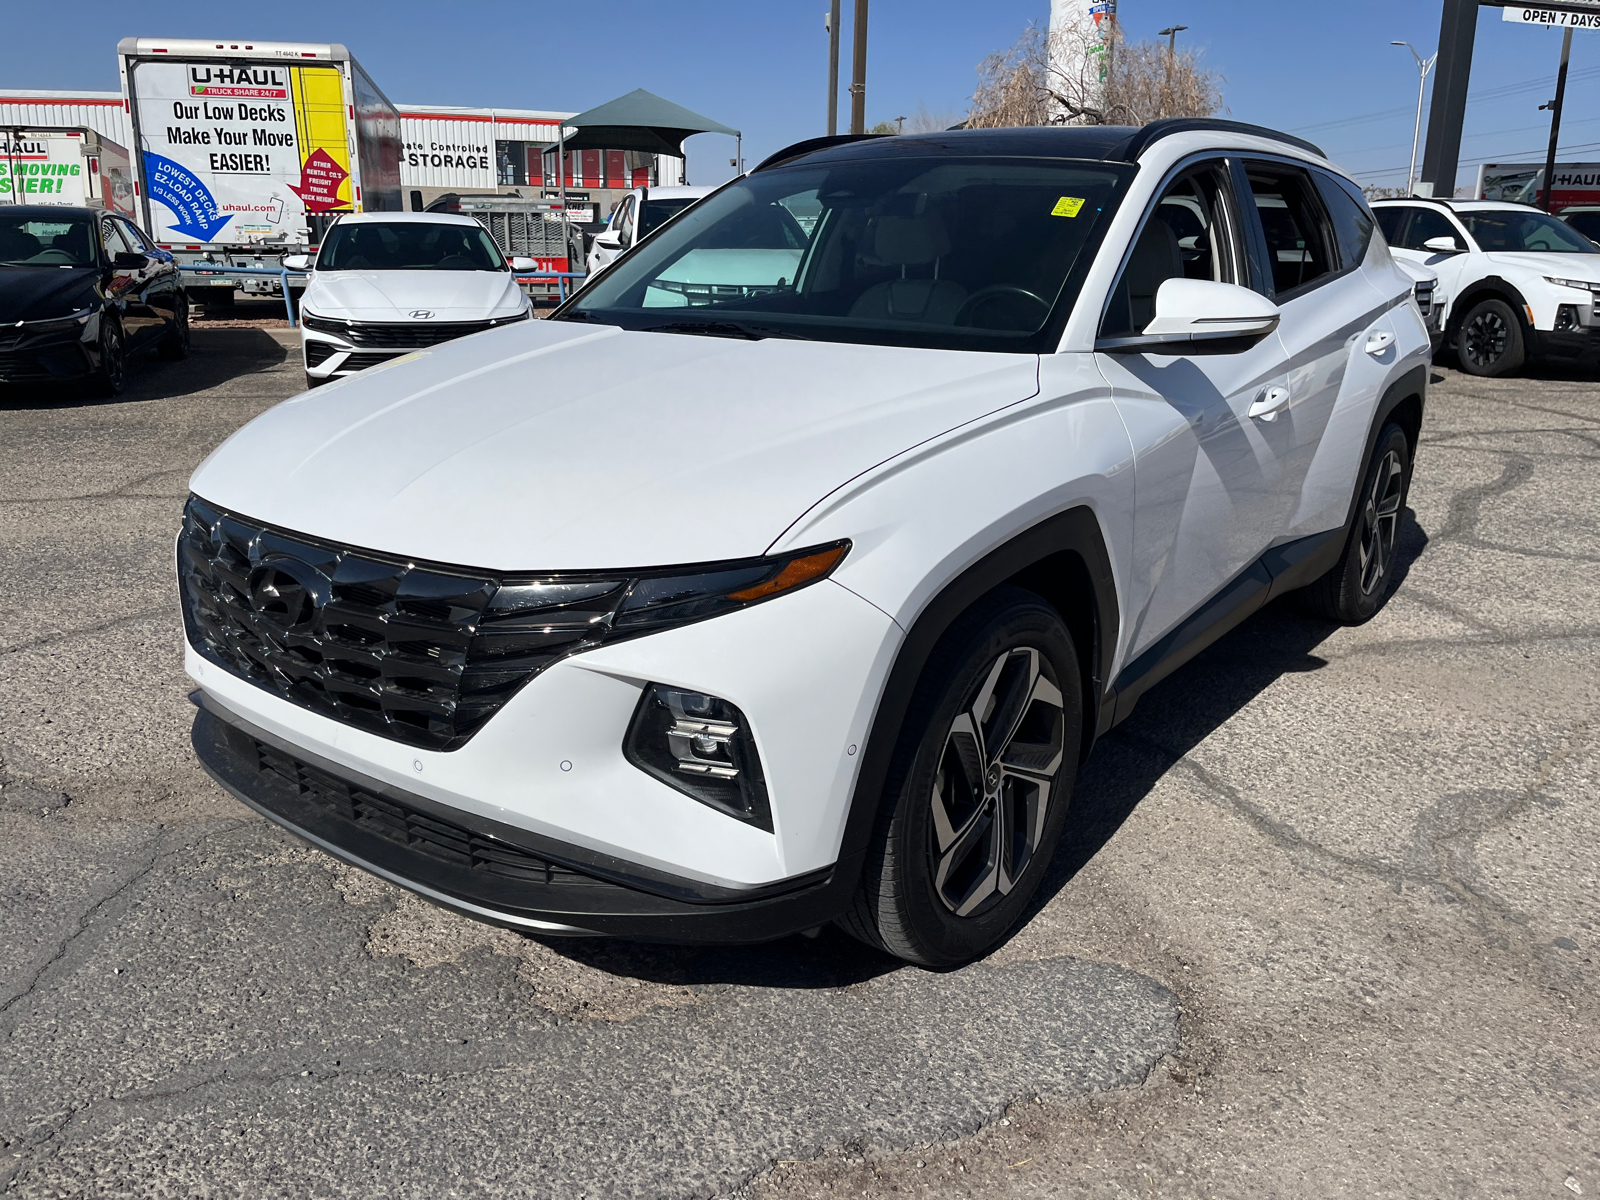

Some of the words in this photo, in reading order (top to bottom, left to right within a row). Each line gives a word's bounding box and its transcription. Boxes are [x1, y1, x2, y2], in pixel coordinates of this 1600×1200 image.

[1522, 10, 1556, 23] OPEN
[1560, 13, 1568, 24] 7
[1570, 14, 1600, 28] DAYS
[192, 67, 284, 86] U-HAUL
[174, 101, 200, 120] Our
[204, 102, 234, 120] Low
[238, 103, 286, 122] Decks
[166, 126, 210, 144] Make
[214, 127, 248, 146] Your
[252, 128, 294, 146] Move
[401, 142, 423, 150] ate
[430, 142, 488, 154] Controlled
[14, 164, 80, 176] MOVING
[210, 153, 270, 172] EASIER!
[313, 160, 332, 168] OTHER
[408, 153, 488, 170] STORAGE
[306, 168, 327, 176] RENTAL
[308, 178, 332, 186] FREIGHT
[310, 186, 328, 194] TRUCK
[158, 162, 196, 189] LOWEST
[194, 188, 218, 221] DECKS
[316, 196, 336, 204] HEIGHT
[154, 172, 192, 202] EZ-LOAD
[190, 202, 208, 230] RAMP
[154, 186, 164, 195] 1/3
[163, 191, 180, 206] LESS
[178, 204, 192, 226] WORK
[222, 204, 276, 212] uhaul.com
